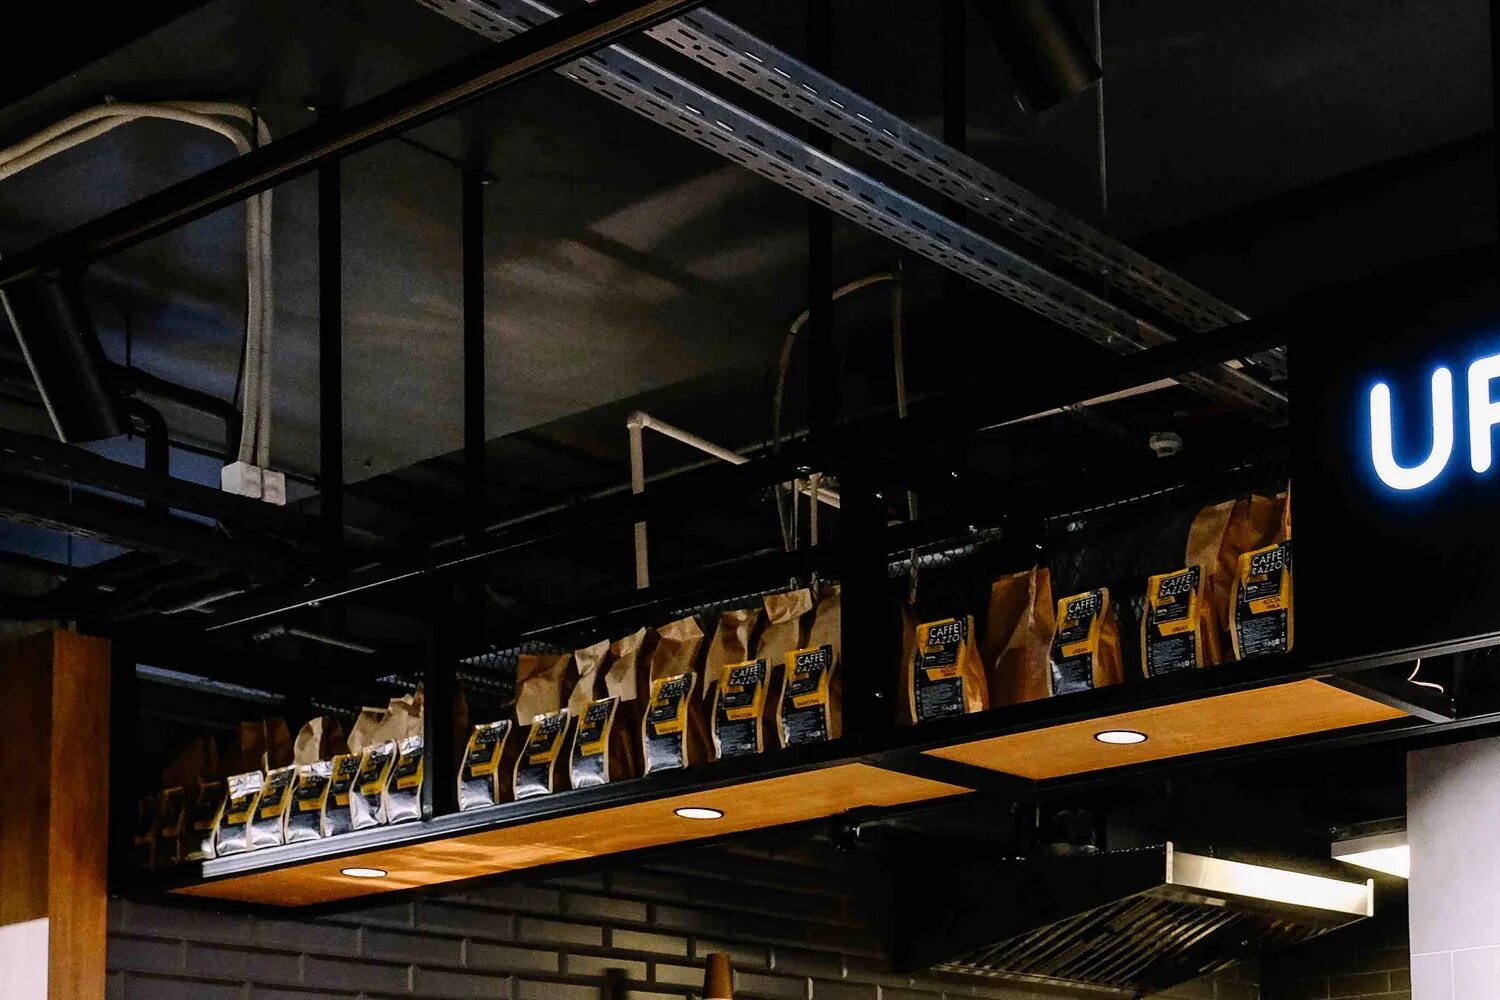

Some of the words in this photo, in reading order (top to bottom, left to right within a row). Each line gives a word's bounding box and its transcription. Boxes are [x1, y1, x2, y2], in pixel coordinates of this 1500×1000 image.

[1252, 550, 1282, 567] CAFFE
[1161, 574, 1192, 589] CAFFE
[930, 624, 959, 638] CAFFE
[797, 651, 825, 666] CAFFE
[731, 665, 759, 679] CAFFE
